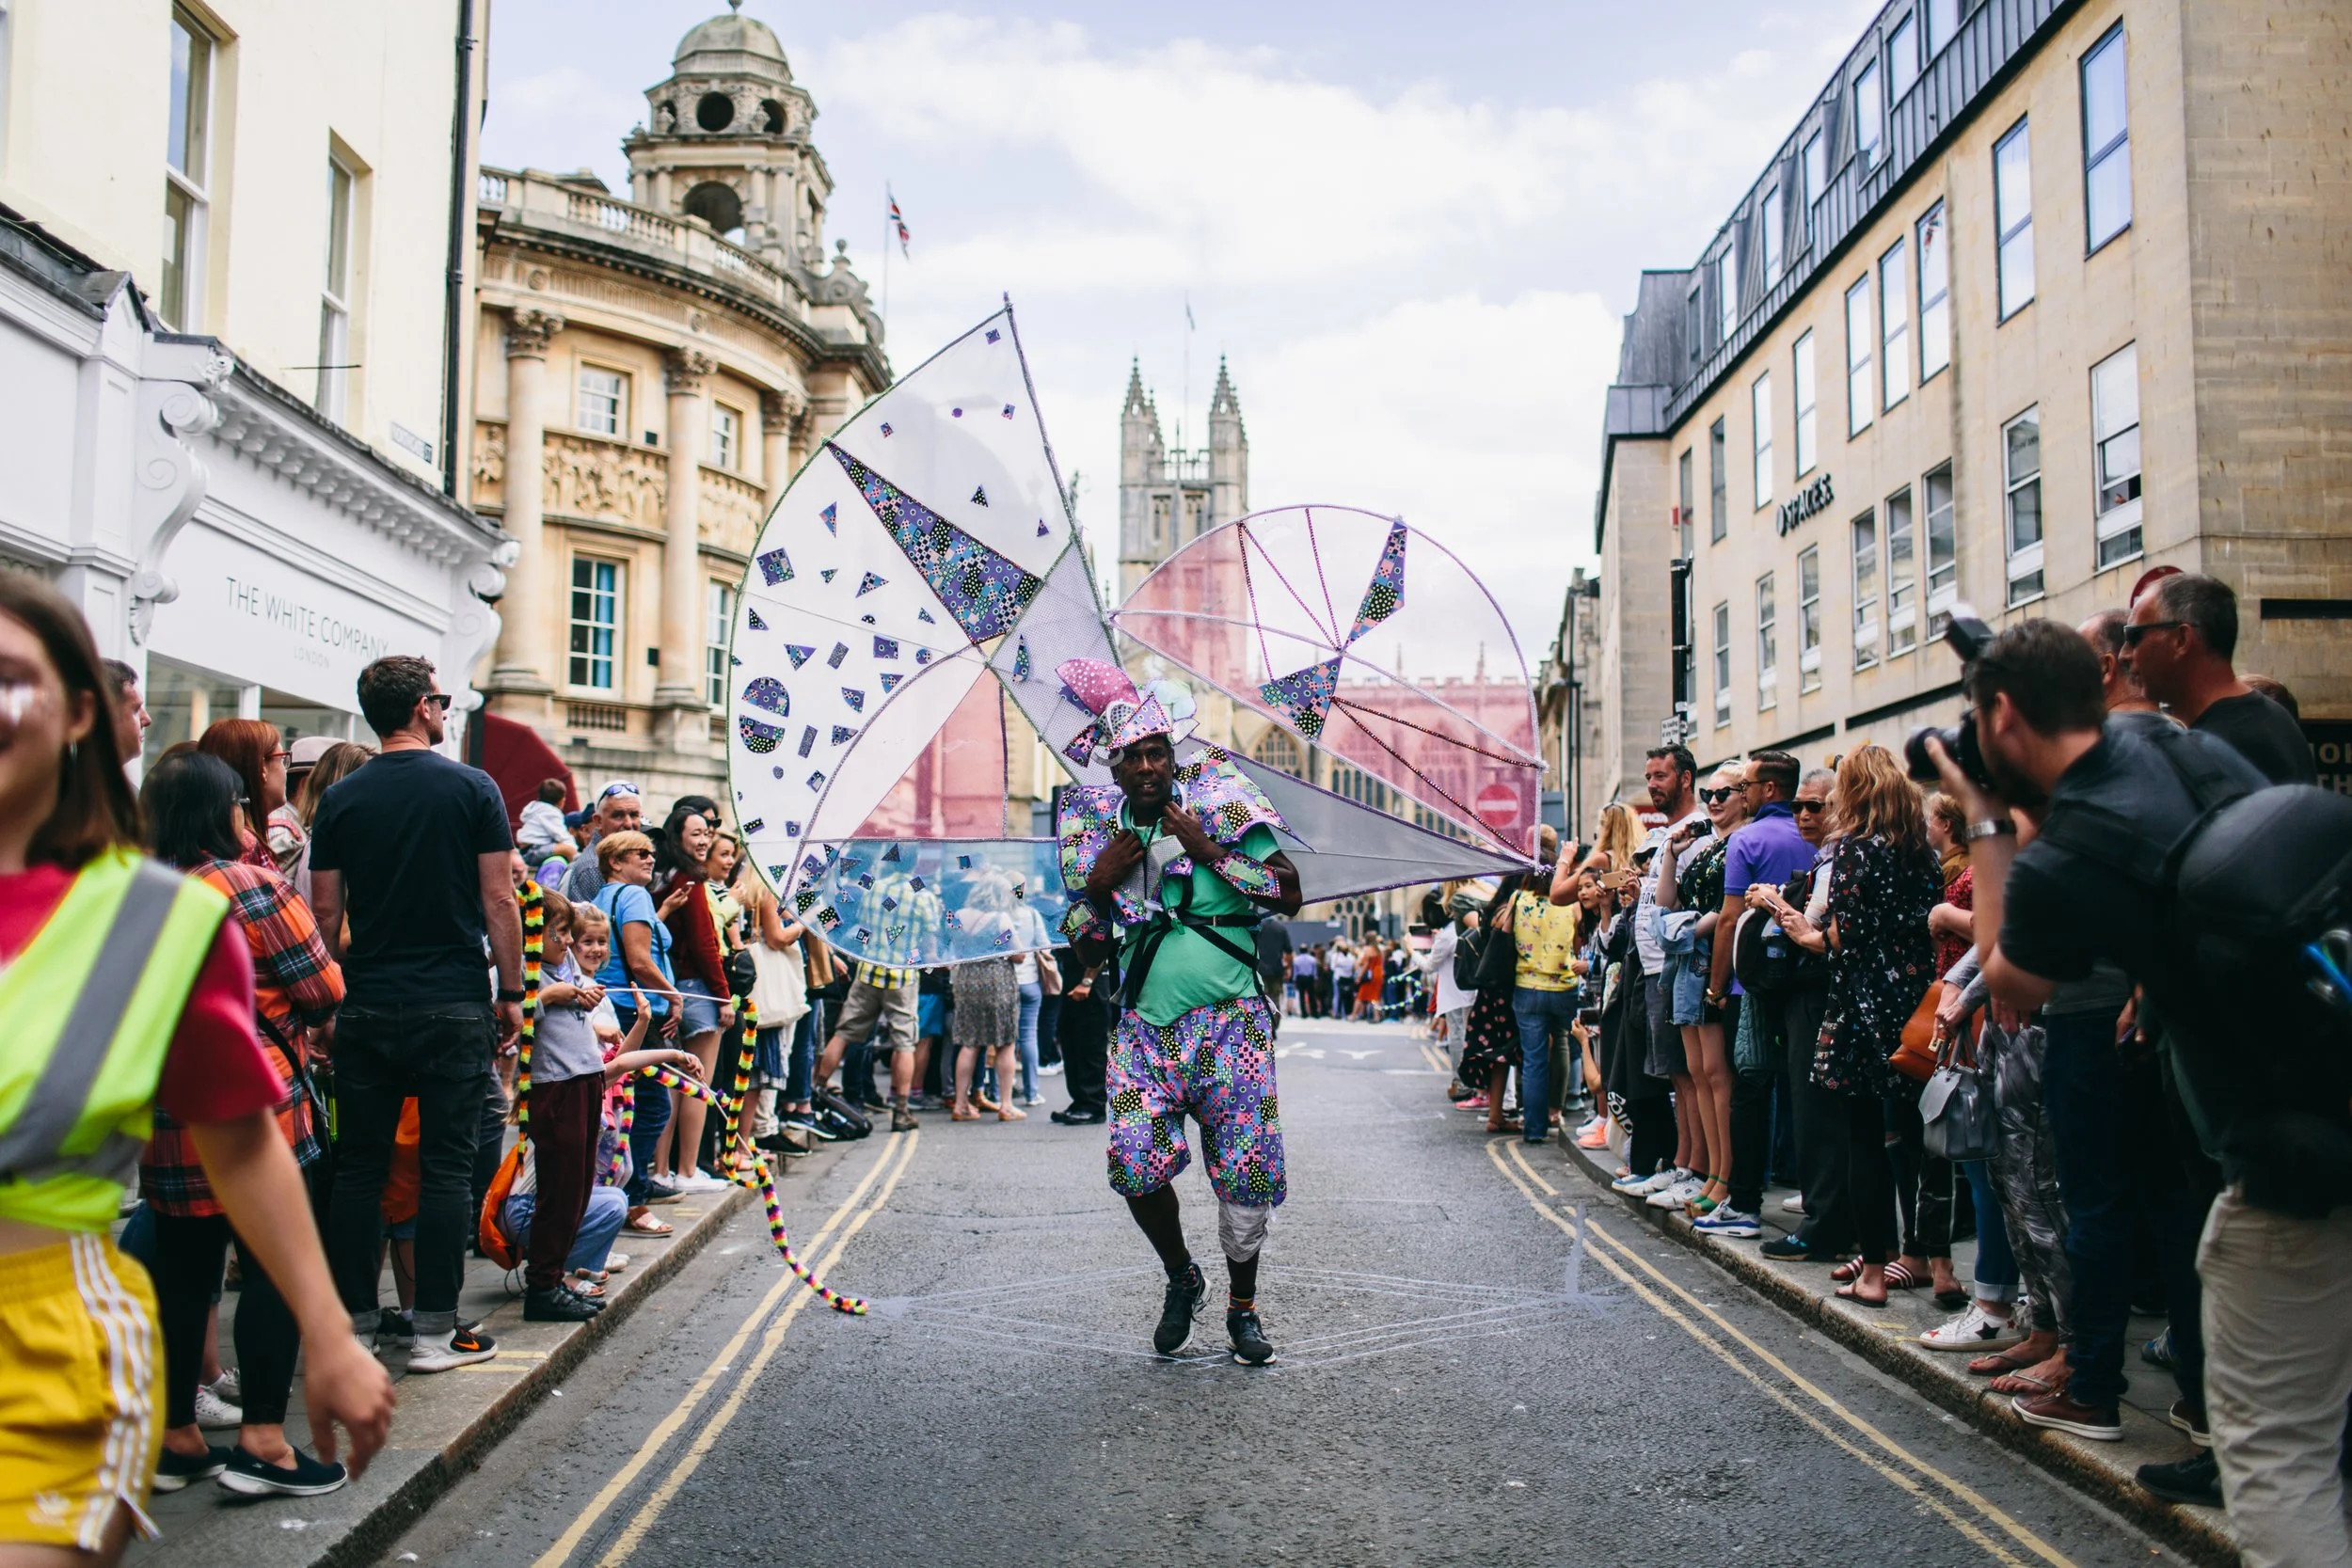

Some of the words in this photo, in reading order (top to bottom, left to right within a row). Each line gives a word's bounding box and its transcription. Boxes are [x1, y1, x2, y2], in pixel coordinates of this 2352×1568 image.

[227, 577, 259, 616] THE
[265, 593, 315, 638] WHITE
[321, 617, 389, 659] COMPANY
[294, 646, 330, 669] LONDON
